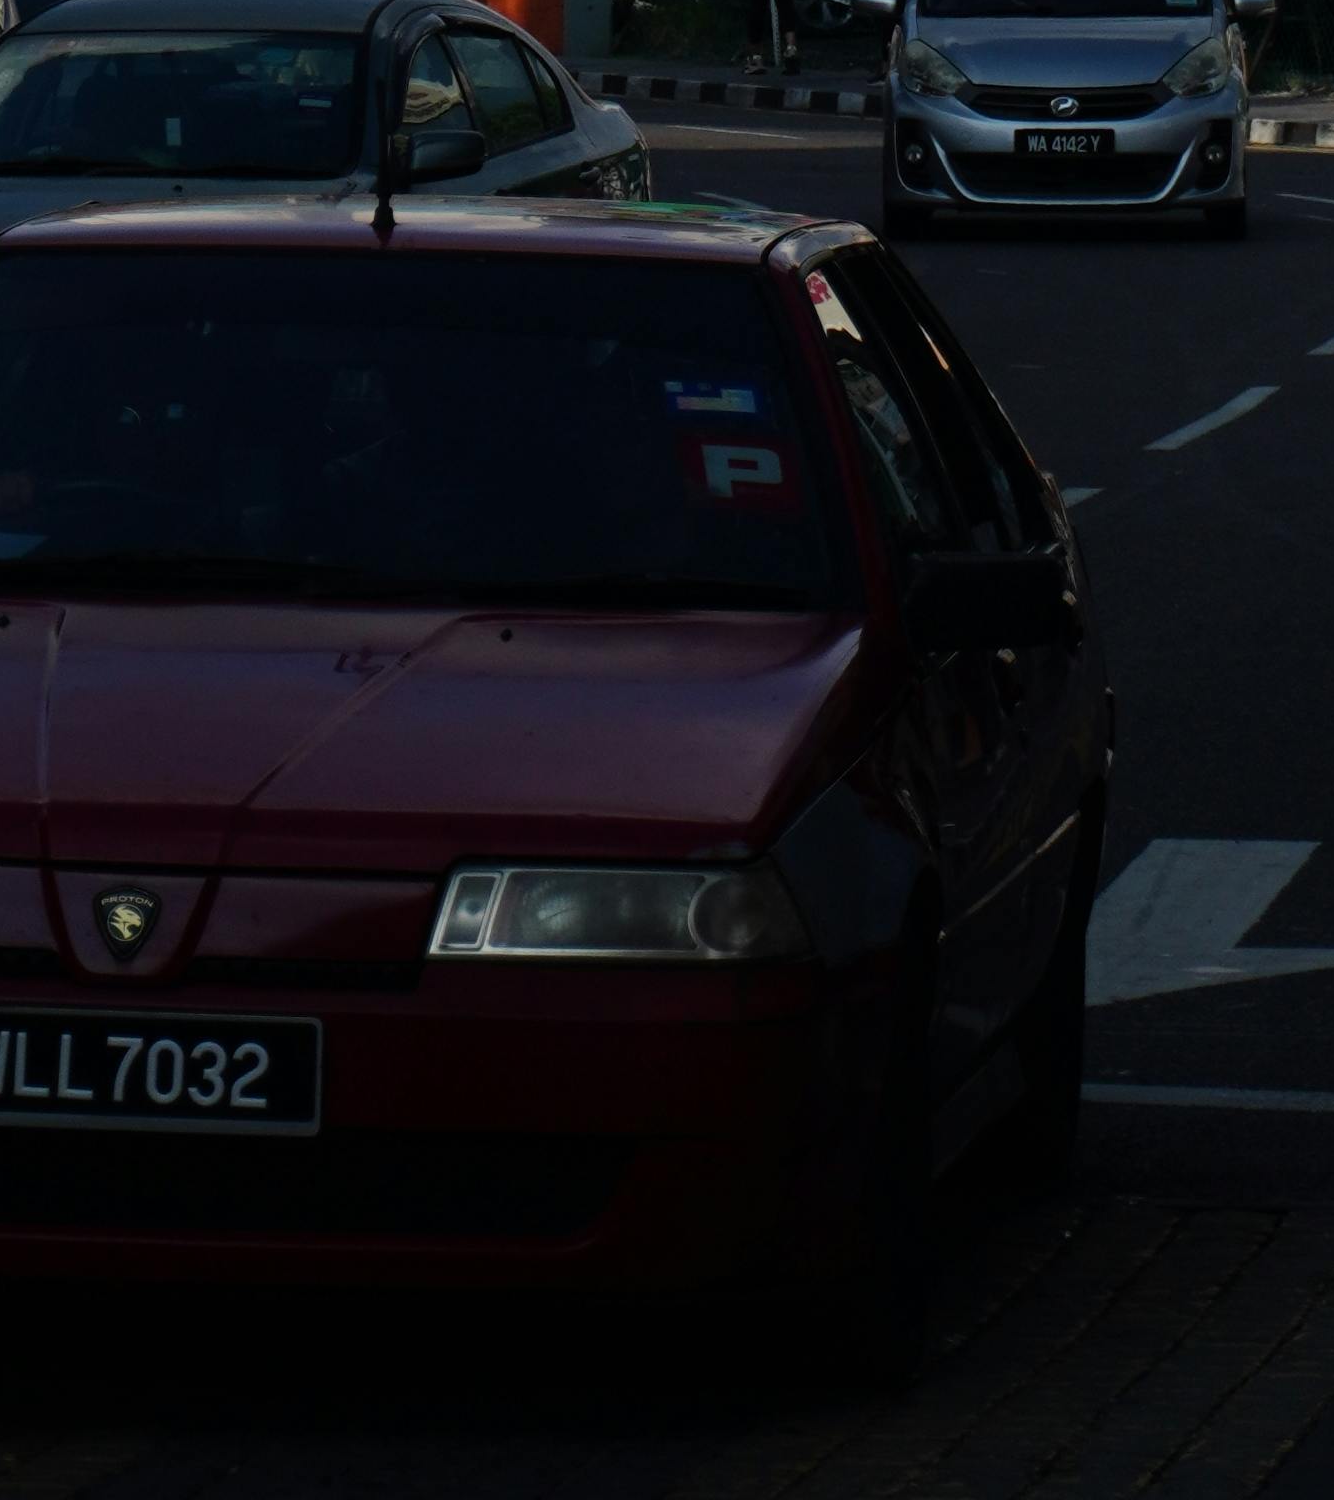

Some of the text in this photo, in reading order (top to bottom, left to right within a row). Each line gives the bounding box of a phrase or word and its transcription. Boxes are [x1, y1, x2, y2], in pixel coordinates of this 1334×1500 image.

[1026, 133, 1101, 153] WA 4142 Y
[700, 443, 783, 499] P
[100, 895, 155, 908] PROTON
[105, 1035, 270, 1109] 7032
